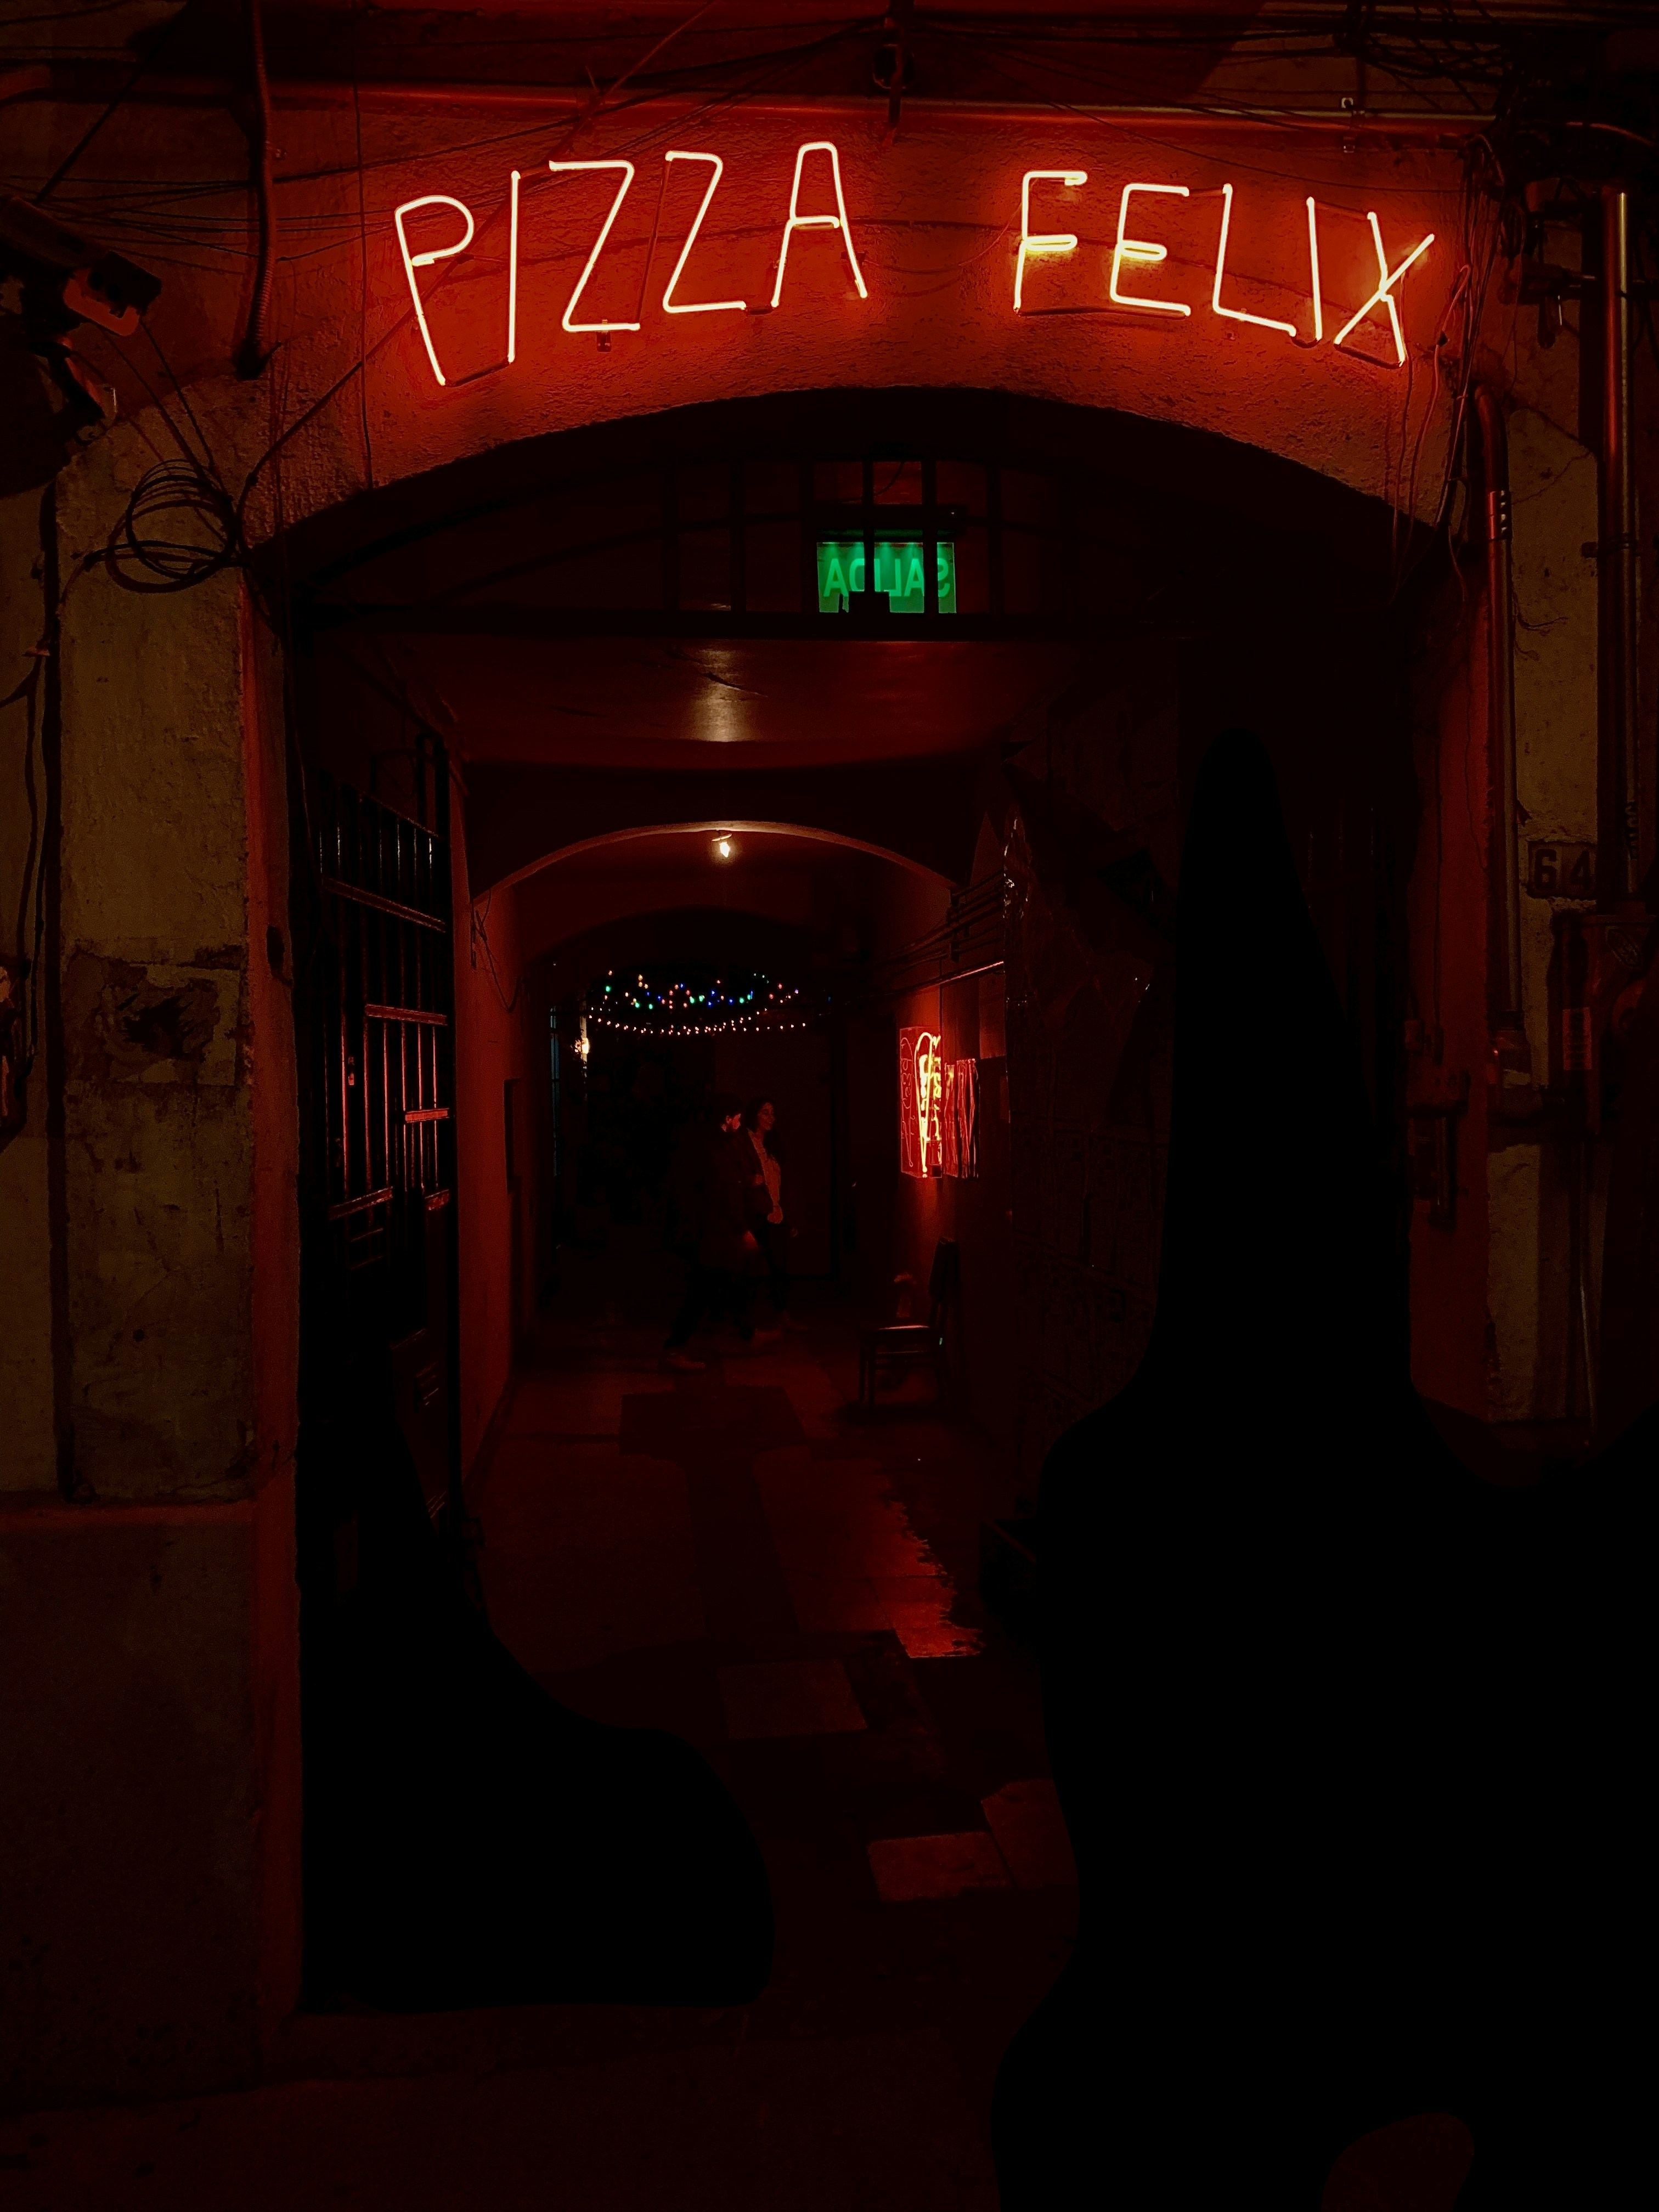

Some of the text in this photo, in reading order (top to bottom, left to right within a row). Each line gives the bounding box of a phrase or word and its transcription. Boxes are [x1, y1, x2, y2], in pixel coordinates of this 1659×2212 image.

[394, 141, 1435, 385] PIZZA FELIX
[1534, 848, 1590, 890] 64
